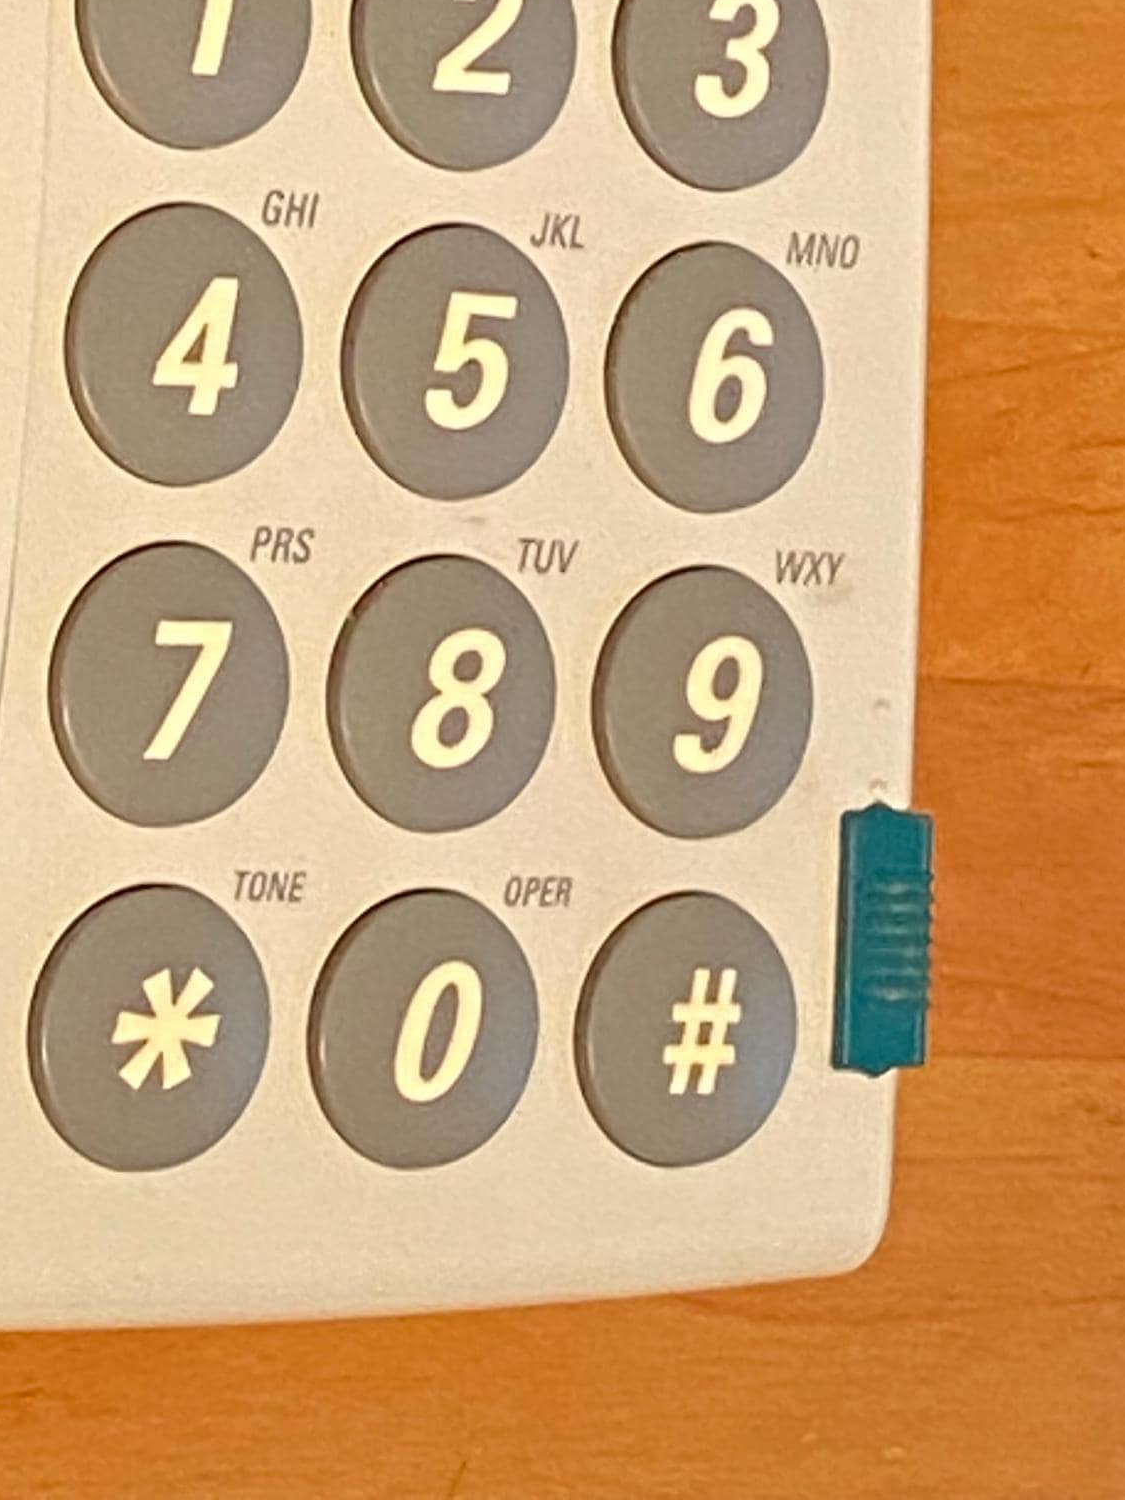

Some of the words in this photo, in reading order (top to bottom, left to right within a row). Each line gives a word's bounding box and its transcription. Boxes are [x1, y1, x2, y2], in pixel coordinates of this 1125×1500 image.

[261, 189, 320, 229] GHI
[529, 212, 585, 250] JKL
[785, 230, 861, 269] MNO
[152, 277, 239, 416] 4
[425, 291, 518, 430] 5
[689, 308, 774, 443] 6
[249, 525, 316, 565] PRS
[518, 537, 580, 575] TUV
[775, 549, 846, 587] WXY
[143, 620, 233, 760] 7
[411, 629, 506, 768] 8
[673, 636, 763, 773] 9
[234, 870, 307, 904] TONE
[503, 875, 573, 908] OPER
[394, 961, 482, 1102] 0
[662, 968, 742, 1095] #
